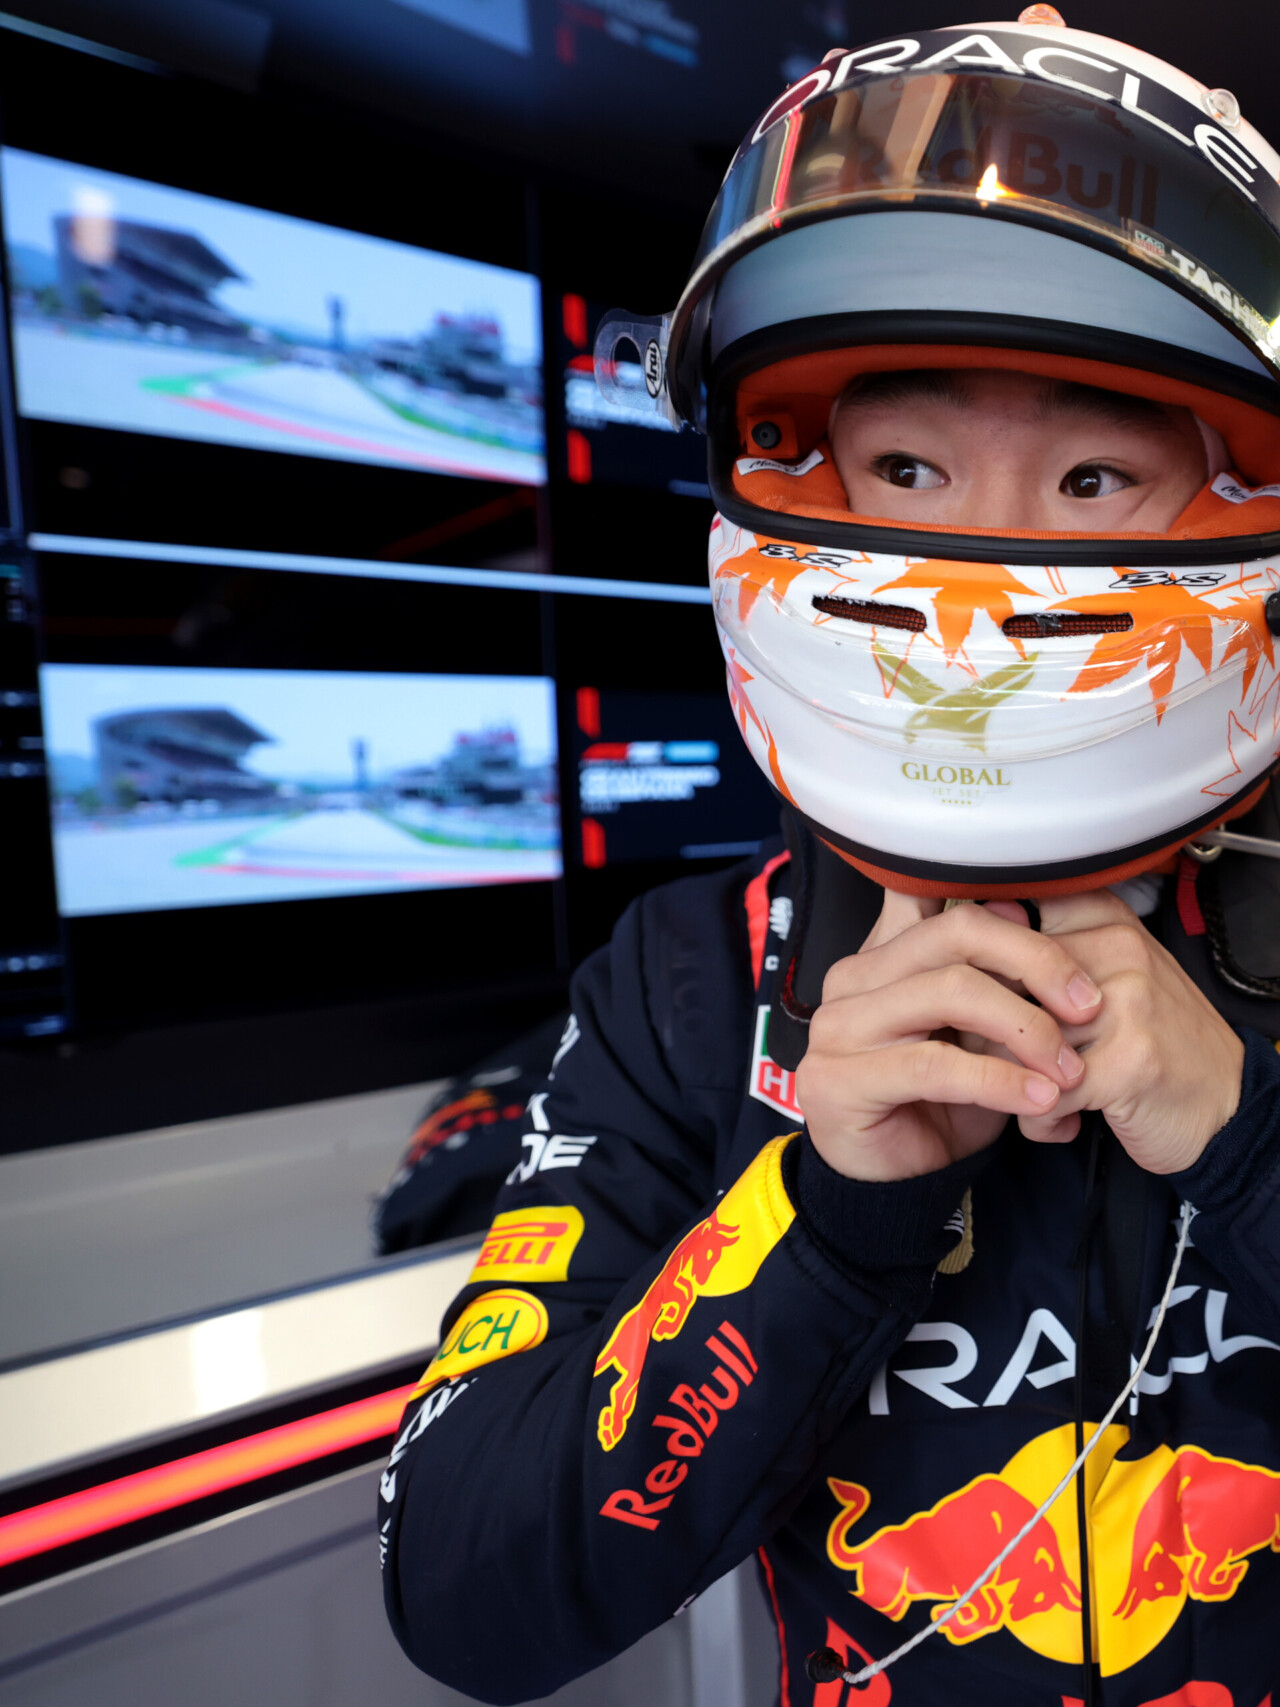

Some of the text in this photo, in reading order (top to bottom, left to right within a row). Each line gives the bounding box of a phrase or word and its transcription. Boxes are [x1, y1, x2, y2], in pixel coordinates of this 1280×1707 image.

[752, 34, 1259, 202] ORACLE
[1007, 130, 1160, 228] Bull
[645, 345, 660, 392] Arai
[901, 761, 1011, 786] GLOBAL
[475, 1238, 558, 1269] ELLI
[437, 1309, 521, 1361] UCH
